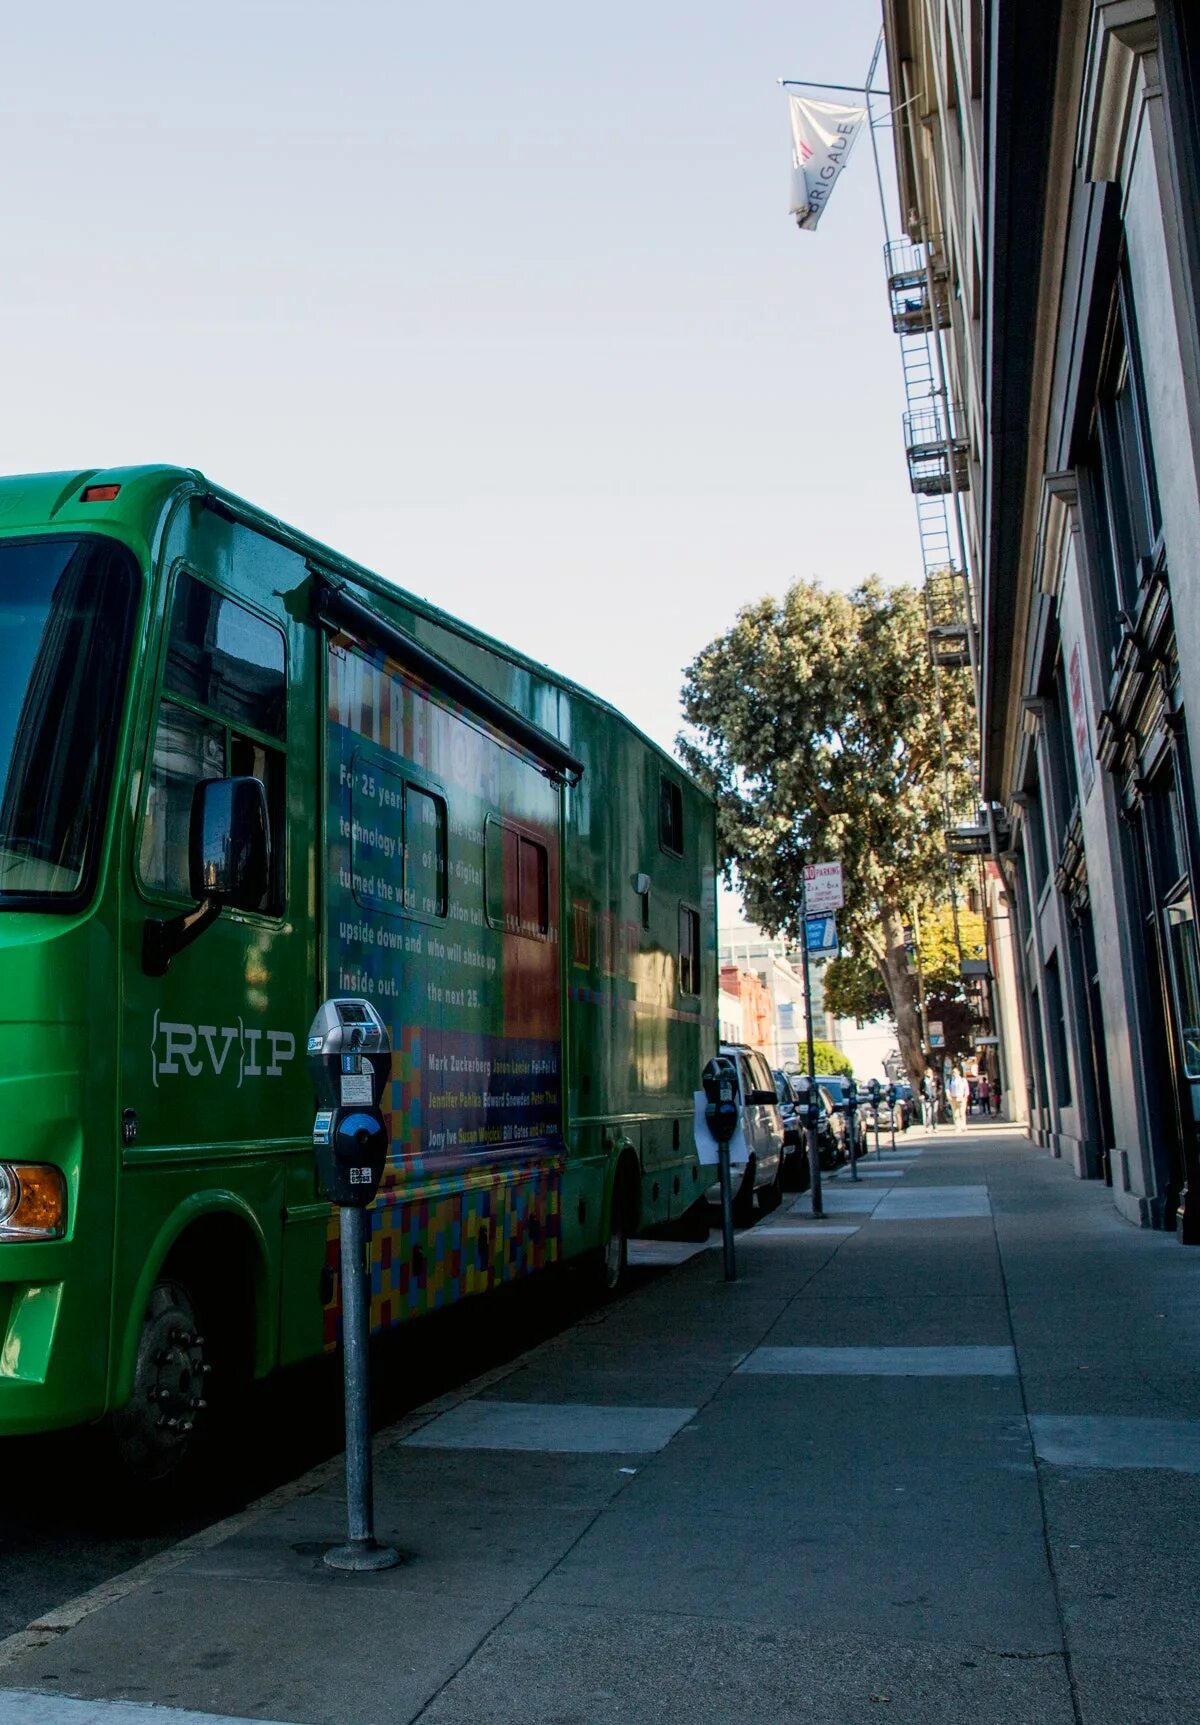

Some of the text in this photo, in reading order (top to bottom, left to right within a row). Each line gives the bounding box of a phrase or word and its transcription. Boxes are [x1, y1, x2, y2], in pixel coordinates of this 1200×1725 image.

[361, 774, 375, 798] 25
[340, 815, 395, 858] technology
[422, 850, 432, 869] of
[455, 860, 482, 885] digital
[804, 865, 840, 880] NO PARKING
[340, 866, 374, 895] turned
[377, 878, 393, 901] the
[340, 920, 422, 954] upside down and
[428, 938, 497, 976] who will shake up
[340, 967, 399, 997] inside out.
[428, 983, 442, 1003] the
[445, 989, 465, 1005] next
[428, 1053, 449, 1072] Mark
[451, 1055, 491, 1077] Zuckerberg
[429, 1129, 446, 1151] Jony
